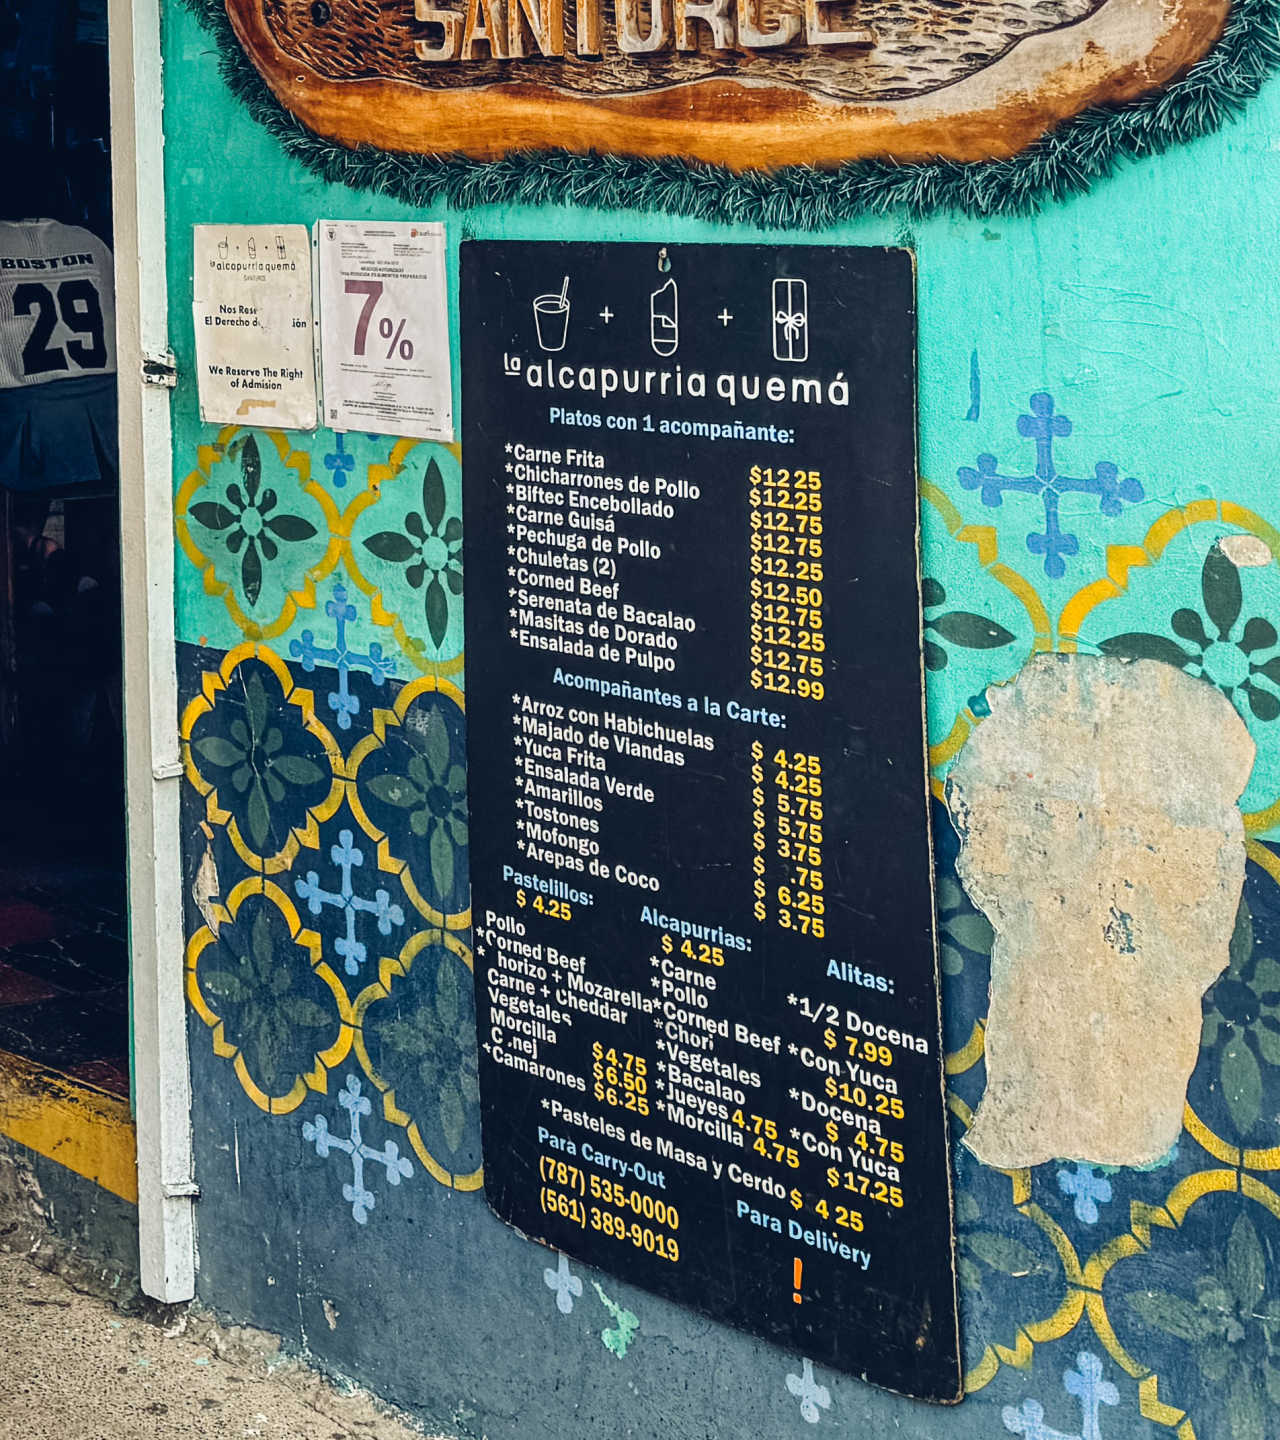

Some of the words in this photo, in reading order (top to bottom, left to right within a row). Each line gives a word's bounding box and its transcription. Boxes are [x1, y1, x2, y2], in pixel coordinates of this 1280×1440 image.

[0, 252, 94, 272] BOSTON
[11, 277, 110, 377] 29
[215, 317, 249, 326] Derecho
[219, 305, 236, 314] Nos
[344, 279, 414, 360] 7%
[208, 365, 224, 376] We
[262, 367, 278, 377] The
[280, 367, 303, 381] Right
[230, 379, 240, 389] of
[242, 379, 282, 390] Admision
[526, 359, 706, 398] alcapurria
[717, 372, 849, 406] quemá
[549, 407, 602, 427] Platos
[606, 416, 638, 431] con
[659, 420, 795, 443] acompañante:
[566, 449, 605, 469] Frita
[628, 475, 650, 494] de
[655, 478, 701, 500] Pollo
[569, 490, 674, 518] Encebollado
[750, 510, 823, 535] $12.75
[568, 511, 615, 532] Guisá
[750, 532, 823, 558] $12.75
[591, 535, 612, 552] de
[617, 537, 661, 559] Pollo
[750, 554, 824, 582] $12.25
[580, 577, 619, 600] Beef
[750, 601, 823, 629] $12.75
[593, 557, 617, 579] (2)
[750, 578, 822, 607] $12.50
[597, 601, 618, 620] de
[623, 604, 696, 632] Bacalao
[751, 622, 826, 652] $12.25
[589, 621, 609, 639] de
[614, 624, 678, 650] Dorado
[751, 644, 824, 677] $12.75
[599, 643, 620, 662] de
[625, 646, 675, 672] Pulpo
[751, 668, 825, 701] $12.99
[553, 667, 682, 709] Acompañantes
[727, 701, 786, 728] Carte:
[568, 708, 599, 726] con
[604, 712, 715, 751] Habichuelas
[773, 749, 822, 775] 4.25
[567, 747, 606, 771] Frita
[777, 793, 823, 821] 5.75
[589, 731, 610, 750] de
[614, 735, 685, 766] Viandas
[775, 771, 823, 797] 4.25
[604, 775, 655, 803] Verde
[777, 816, 823, 844] 5.75
[777, 838, 822, 866] 3.75
[503, 865, 594, 906] Pastelillos:
[589, 859, 610, 879] de
[615, 865, 660, 892] Coco
[777, 886, 825, 915] 6.25
[486, 910, 526, 936] Pollo
[640, 905, 752, 952] Alcapurrias:
[547, 947, 587, 974] Beef
[826, 959, 895, 995] Alitas:
[487, 968, 535, 997] Carne
[490, 1007, 557, 1044] Morcilla
[735, 1023, 781, 1055] Beef
[846, 1010, 929, 1055] Docena
[844, 1035, 893, 1067] 7.99
[825, 1076, 905, 1120] $10.25
[845, 1061, 898, 1095] Yuca
[731, 1109, 778, 1141] 4.75
[538, 1126, 577, 1156] Para
[582, 1143, 666, 1190] Carry-Out
[630, 1129, 653, 1151] de
[656, 1136, 707, 1172] Masa
[727, 1163, 786, 1200] Cerdo
[753, 1137, 800, 1169] 4.75
[848, 1146, 900, 1183] Yuca
[854, 1130, 905, 1164] 4.75
[539, 1155, 586, 1197] (787)
[590, 1174, 679, 1230] 535-0000
[540, 1186, 586, 1230] (561)
[590, 1207, 679, 1263] 389-9019
[736, 1199, 783, 1234] Para
[788, 1219, 871, 1271] Delivery
